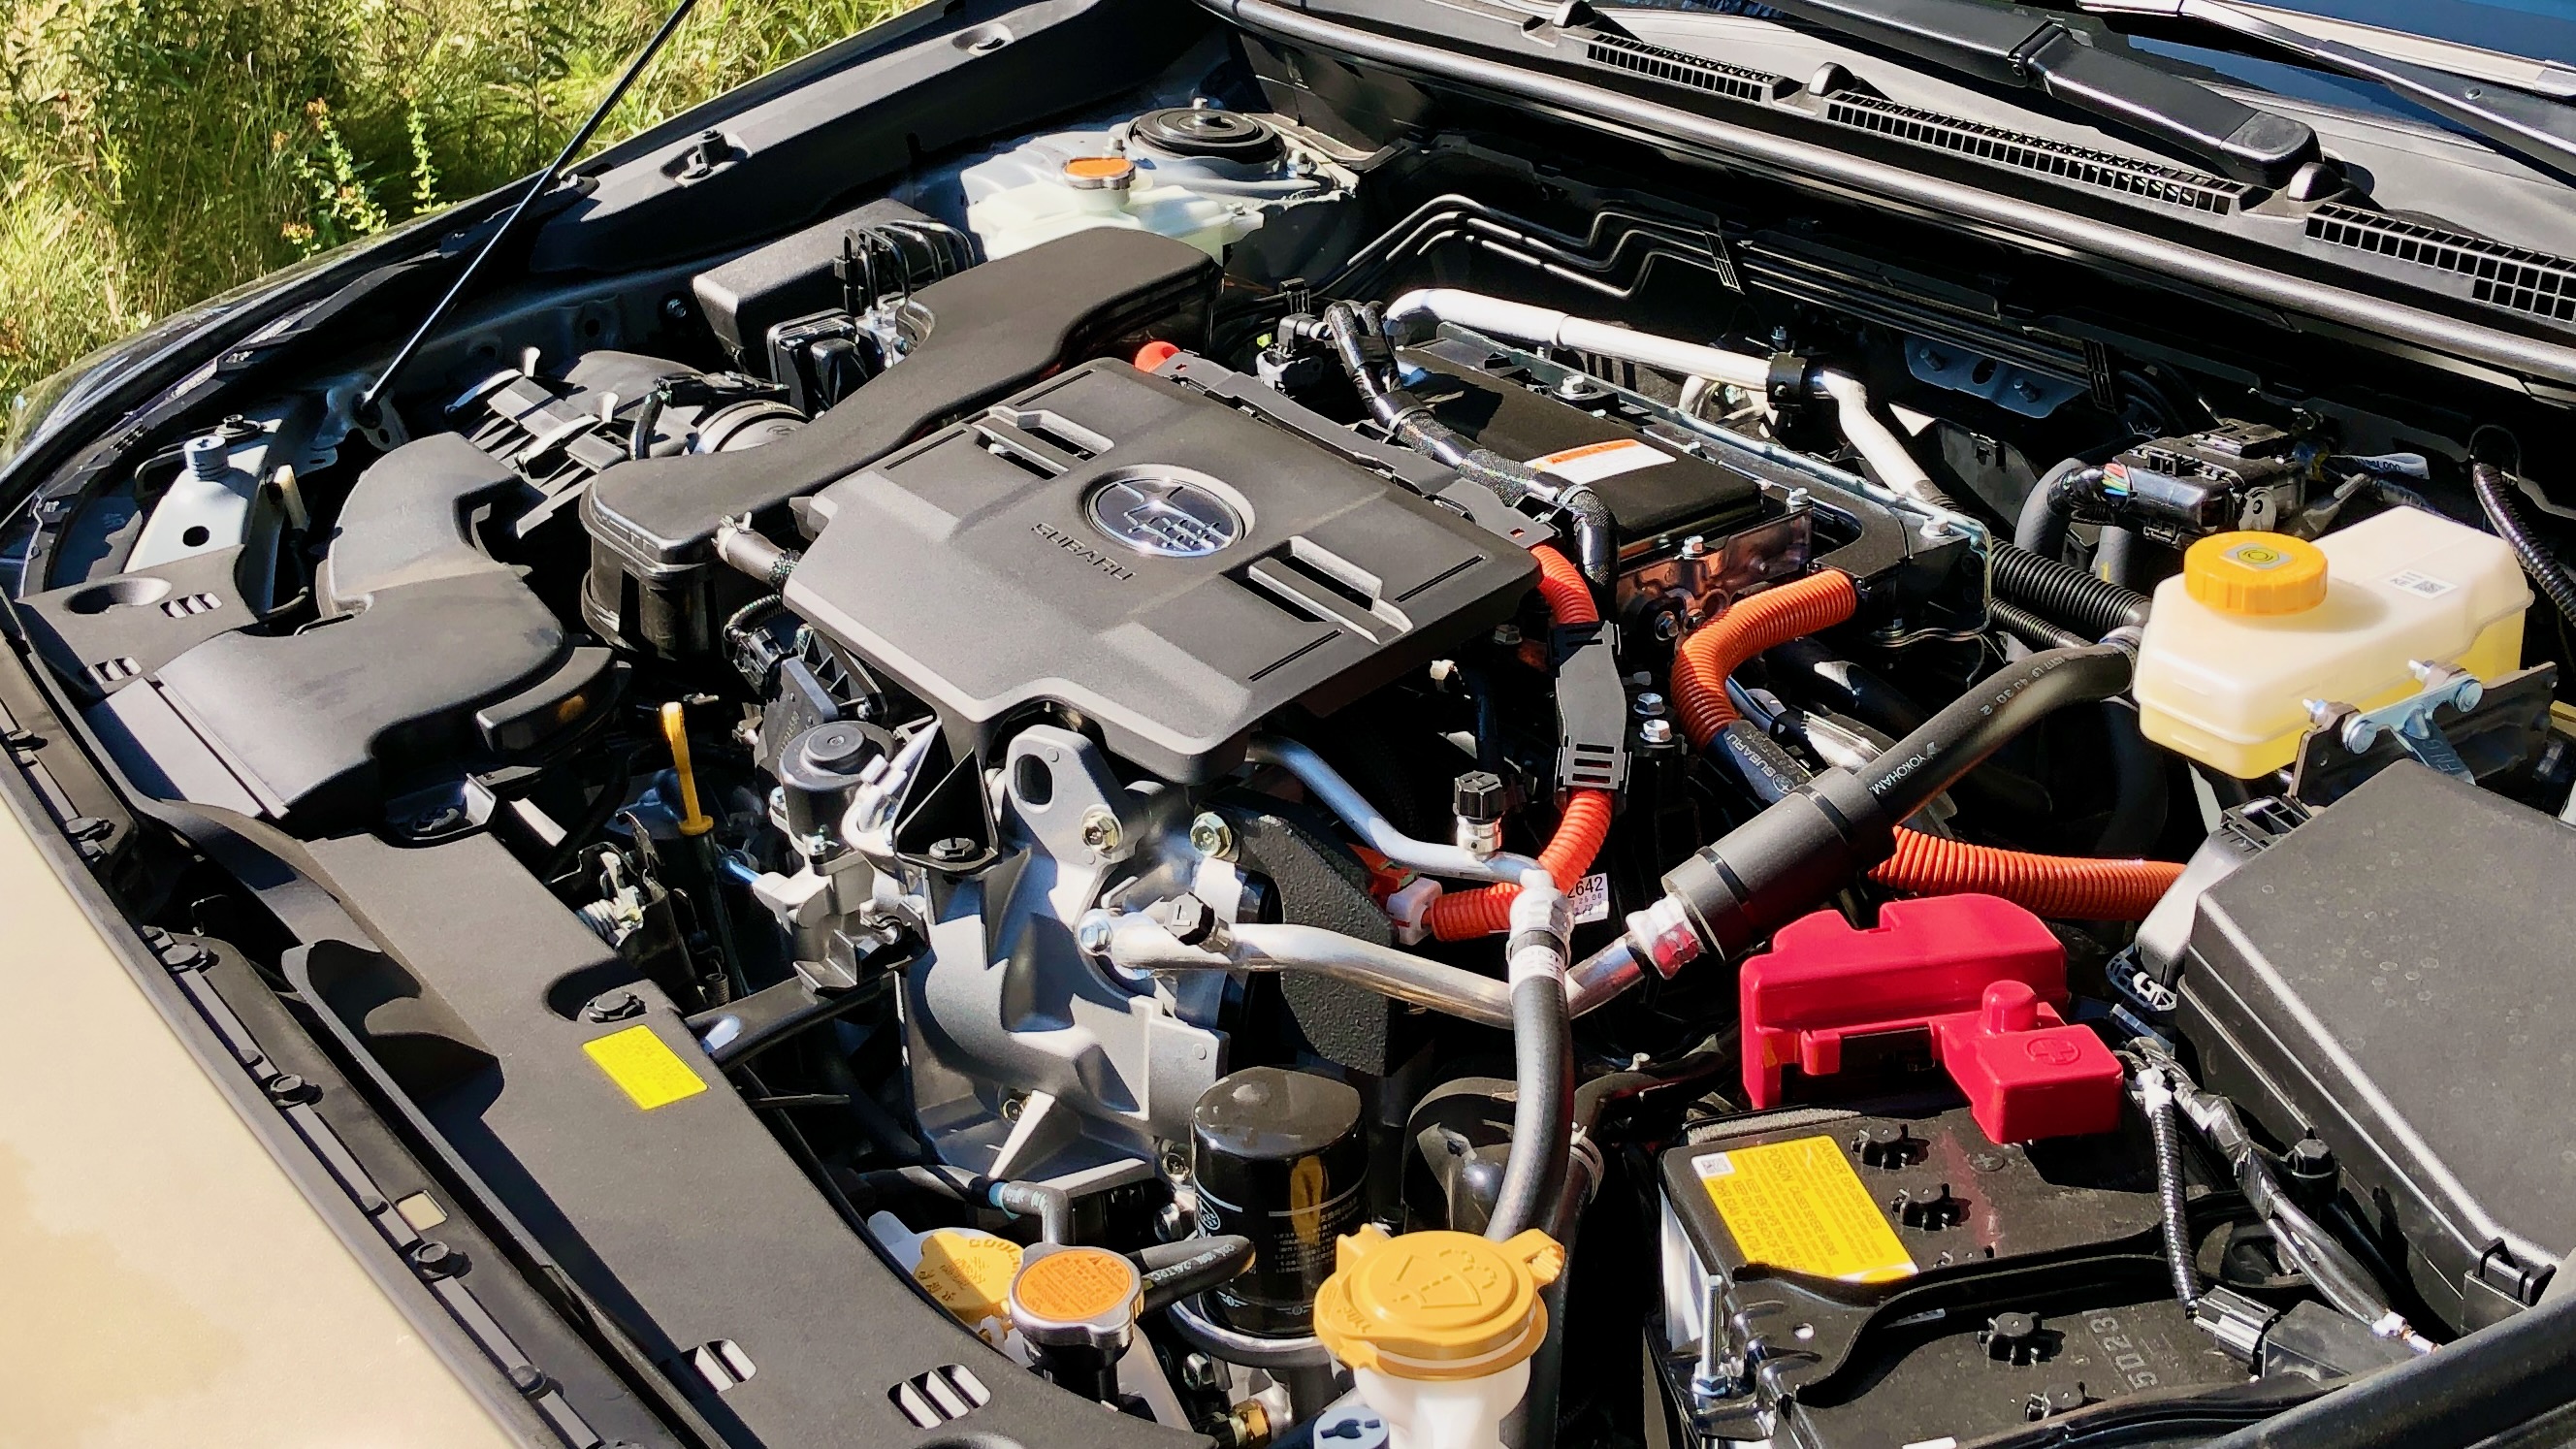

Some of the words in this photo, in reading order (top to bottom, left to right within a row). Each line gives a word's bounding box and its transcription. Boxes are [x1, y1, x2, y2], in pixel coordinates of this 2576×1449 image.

[1031, 523, 1137, 581] SUBARU
[1726, 733, 1777, 778] SUBARU
[1868, 753, 1926, 795] YOKOHAM
[1764, 1148, 1796, 1181] POISON
[1817, 1140, 1849, 1174] DANGER
